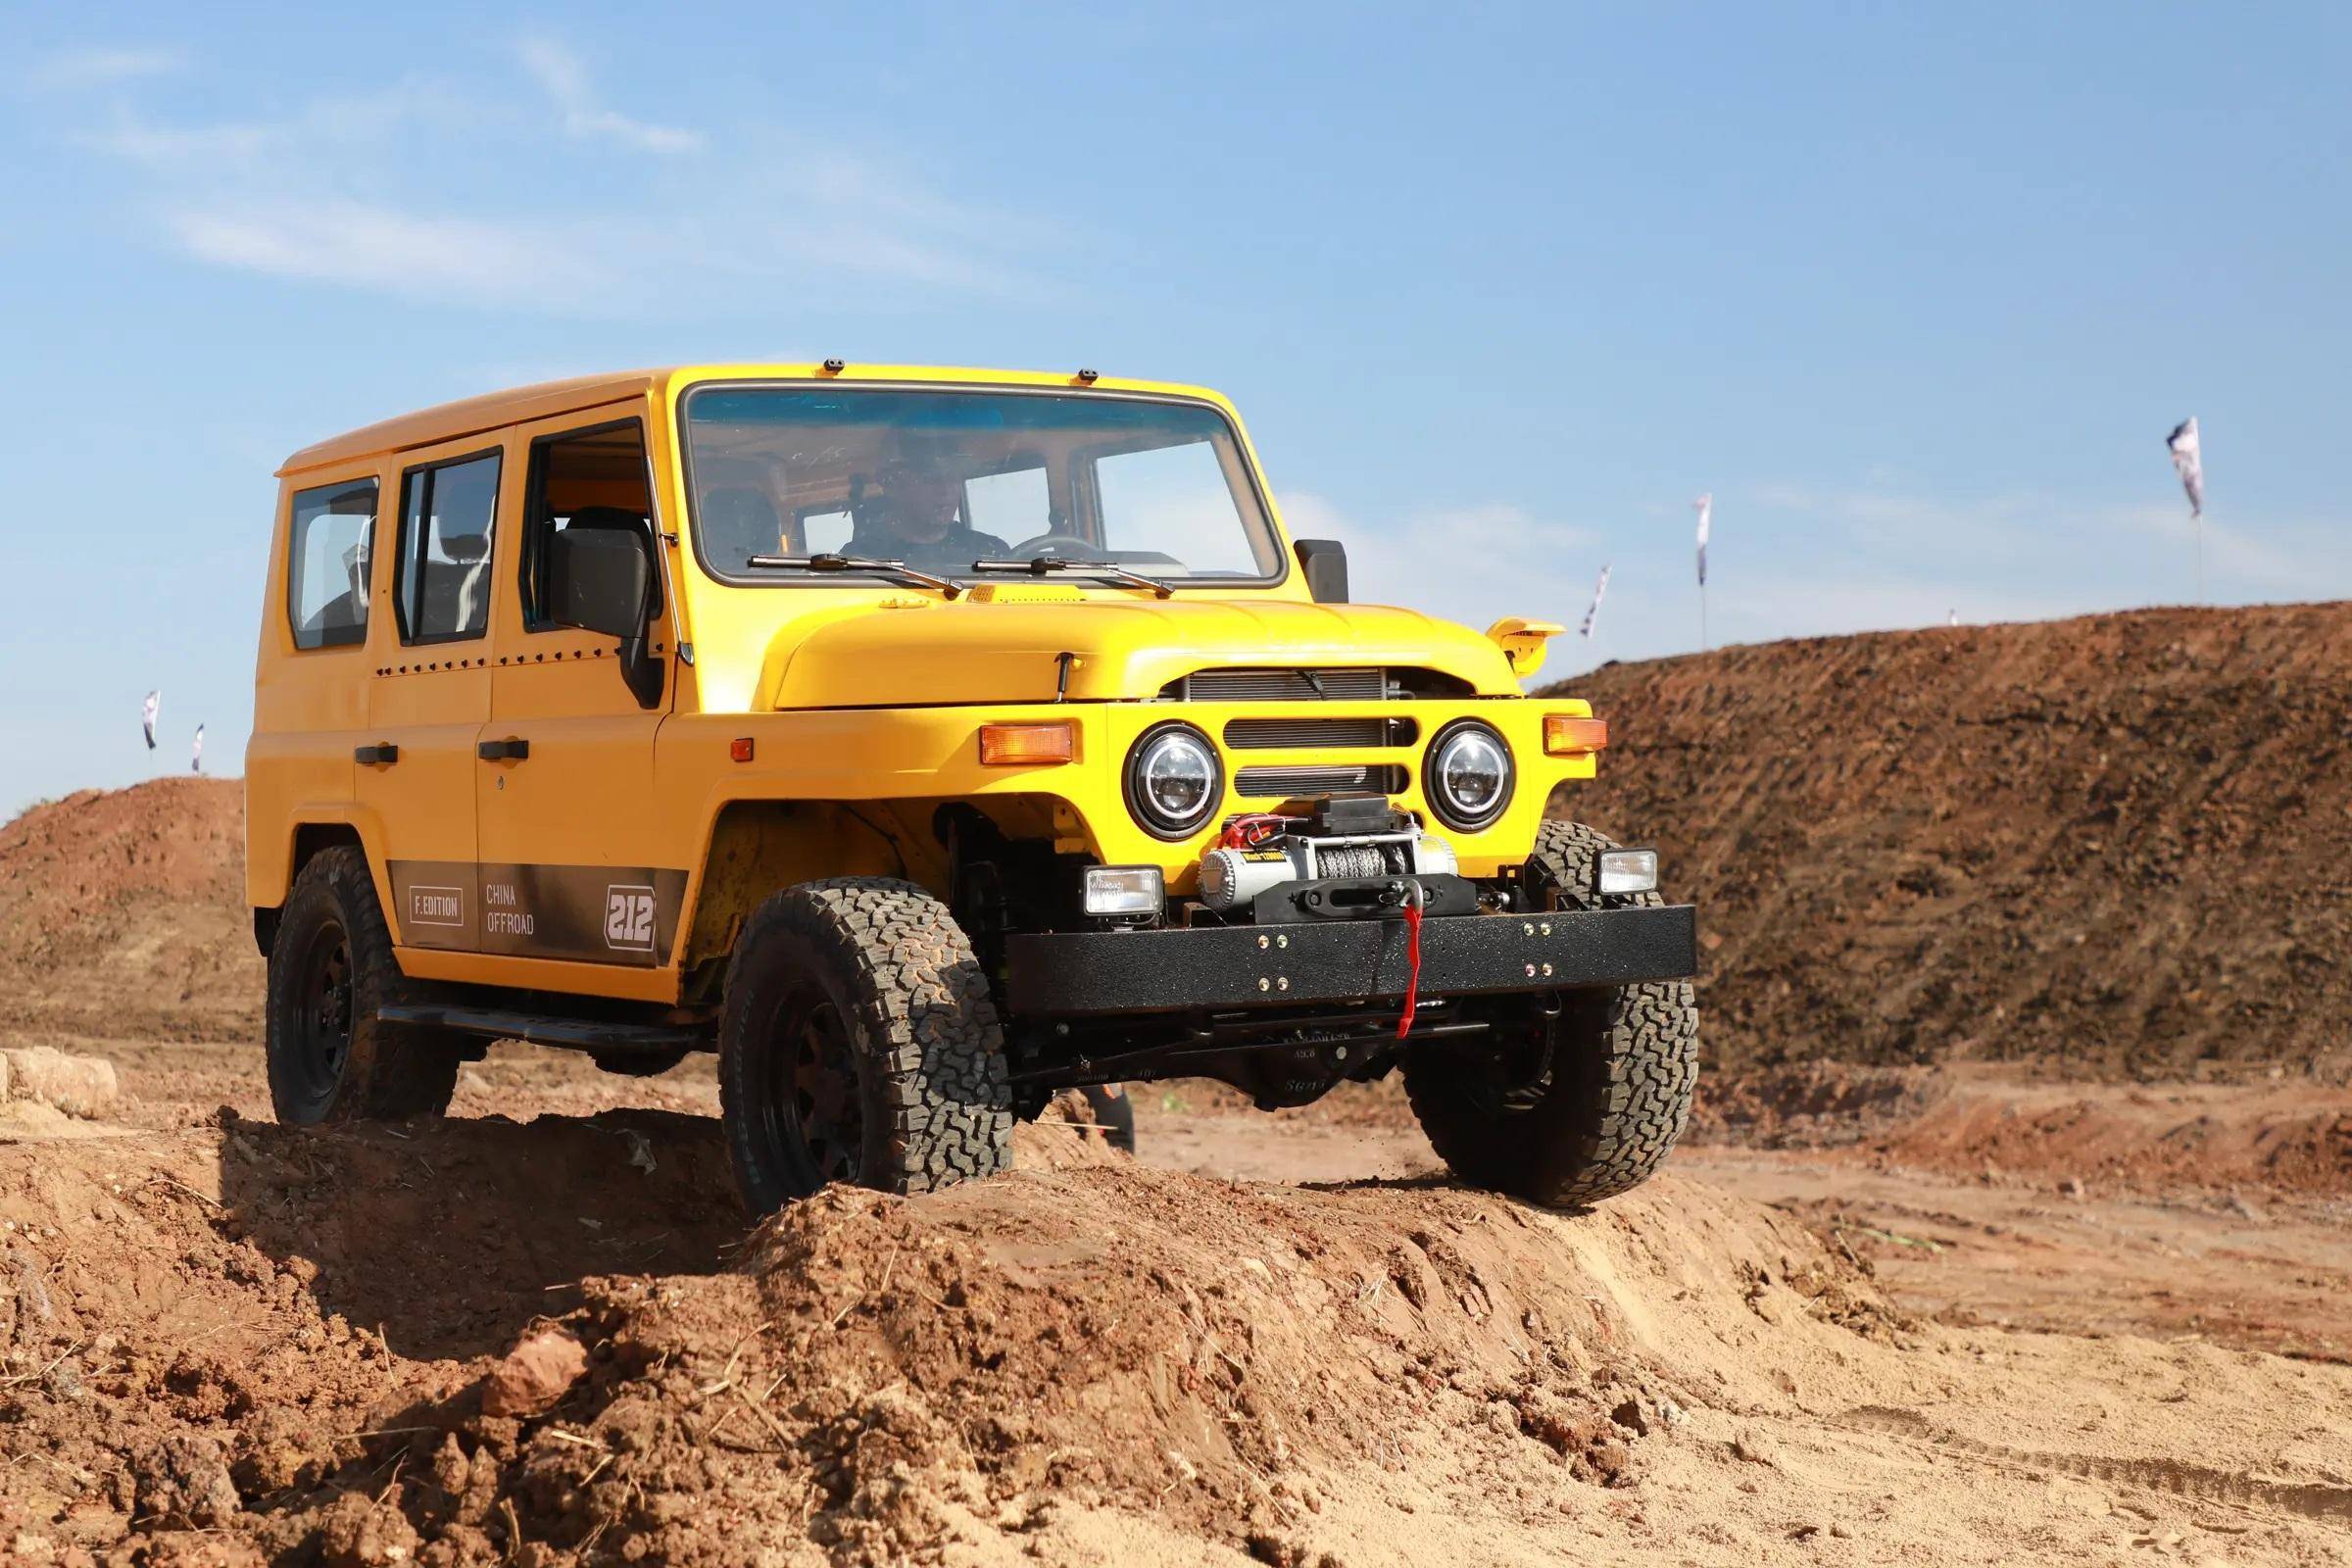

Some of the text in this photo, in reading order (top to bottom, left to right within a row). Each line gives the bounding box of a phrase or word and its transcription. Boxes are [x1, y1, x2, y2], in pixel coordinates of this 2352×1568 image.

[415, 895, 458, 917] F.EDITION
[486, 884, 516, 906] CHINA
[487, 911, 534, 935] OFFROAD
[608, 894, 655, 942] 212
